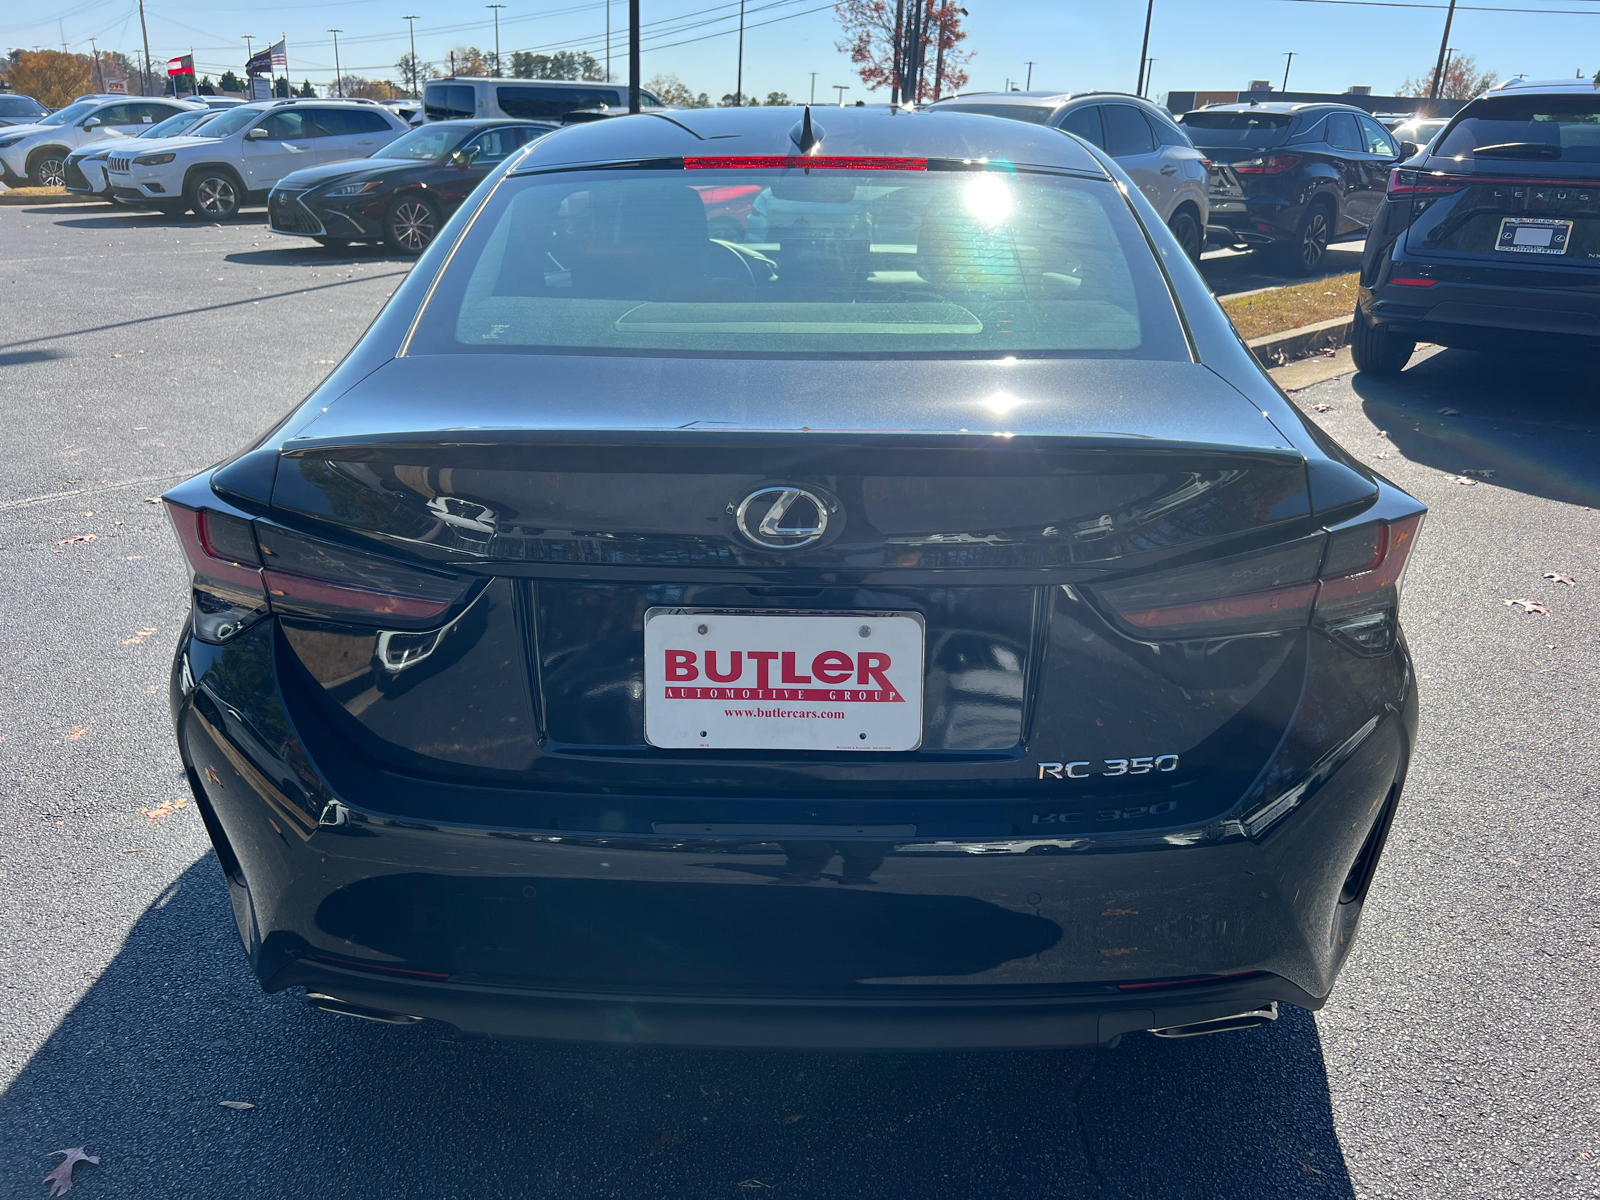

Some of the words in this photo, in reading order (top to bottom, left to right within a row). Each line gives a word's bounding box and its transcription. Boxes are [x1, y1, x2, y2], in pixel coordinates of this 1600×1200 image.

[1494, 191, 1589, 200] LEXUS
[666, 688, 805, 699] AUTOMOTIVE
[829, 689, 896, 701] GROUP
[724, 707, 845, 719] www.butlercars.com
[1037, 761, 1091, 780] RC
[1102, 754, 1180, 777] 350
